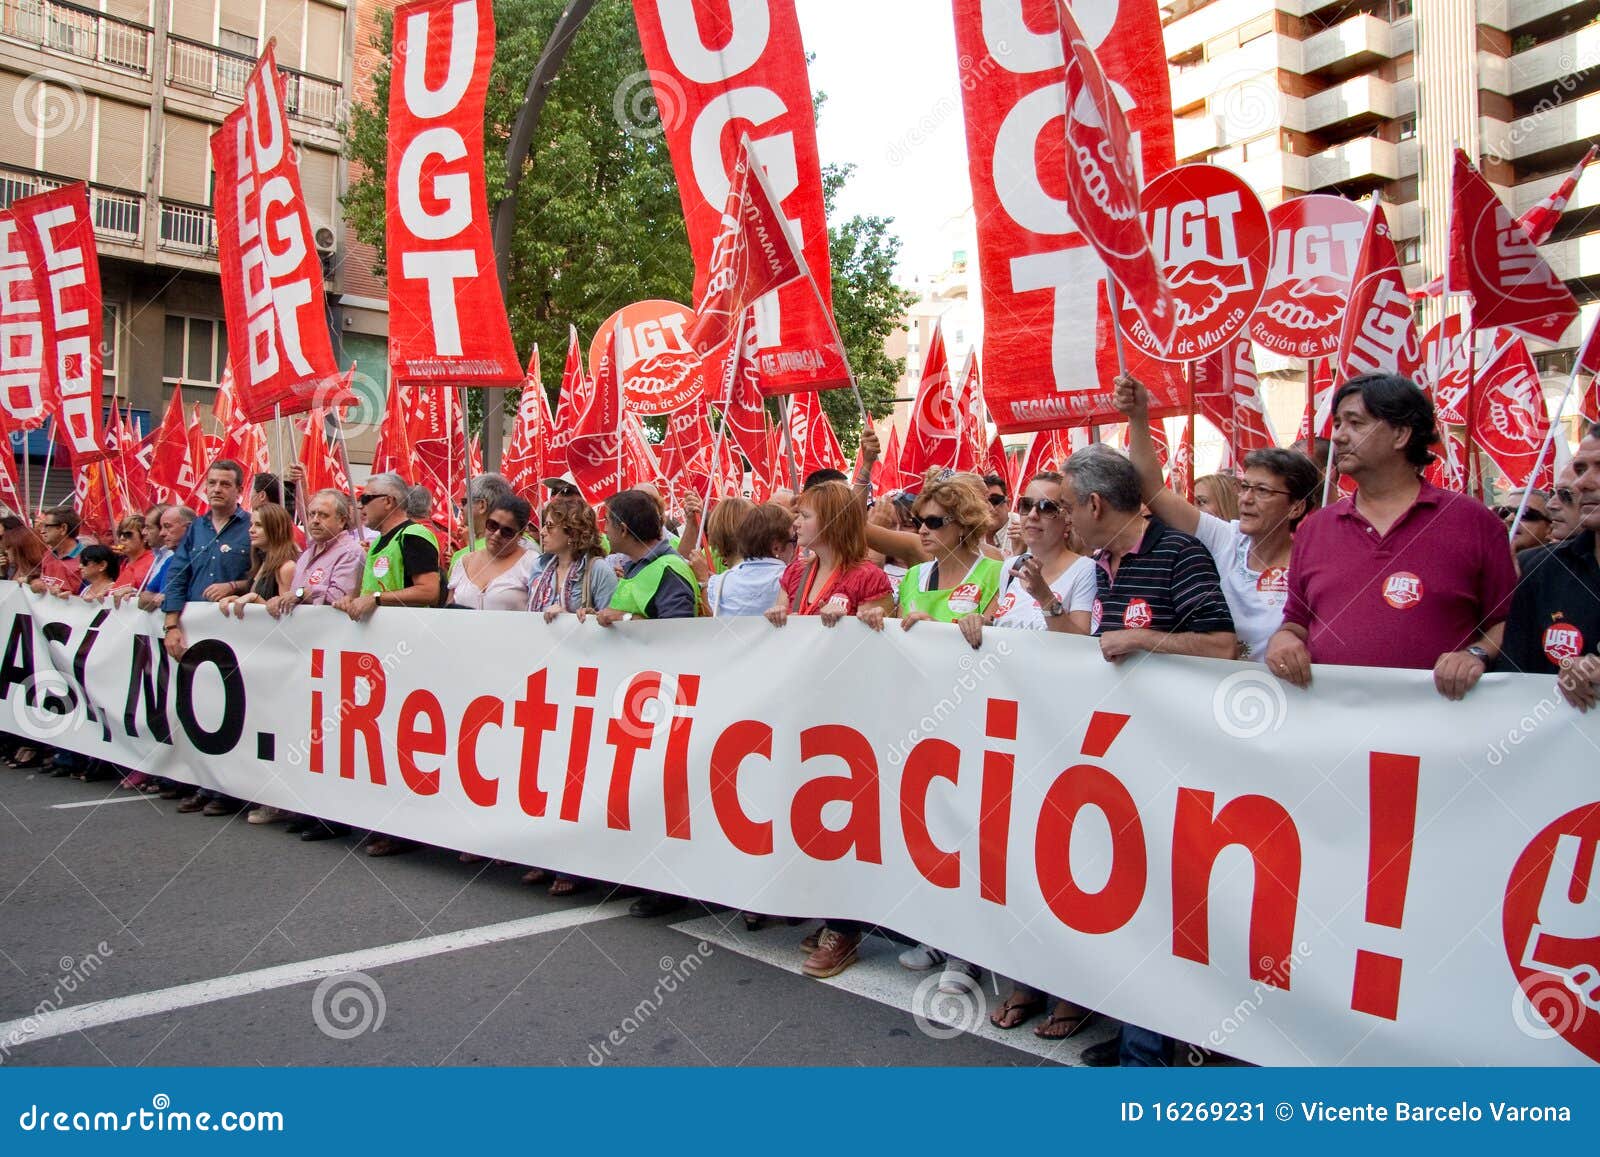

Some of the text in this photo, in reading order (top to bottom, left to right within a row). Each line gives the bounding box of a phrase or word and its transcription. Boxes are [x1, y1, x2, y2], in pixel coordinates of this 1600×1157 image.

[250, 60, 316, 377] UGT
[398, 0, 480, 357] UGT
[33, 206, 100, 453] CCOO
[1178, 338, 1194, 354] de
[1197, 307, 1245, 350] Murcia
[1252, 321, 1296, 352] Región
[1346, 278, 1414, 377] UGT
[1389, 576, 1420, 594] UGT
[1545, 628, 1579, 649] UGT
[0, 607, 1421, 1021] ASÍ, NO. ¡Rectificación!
